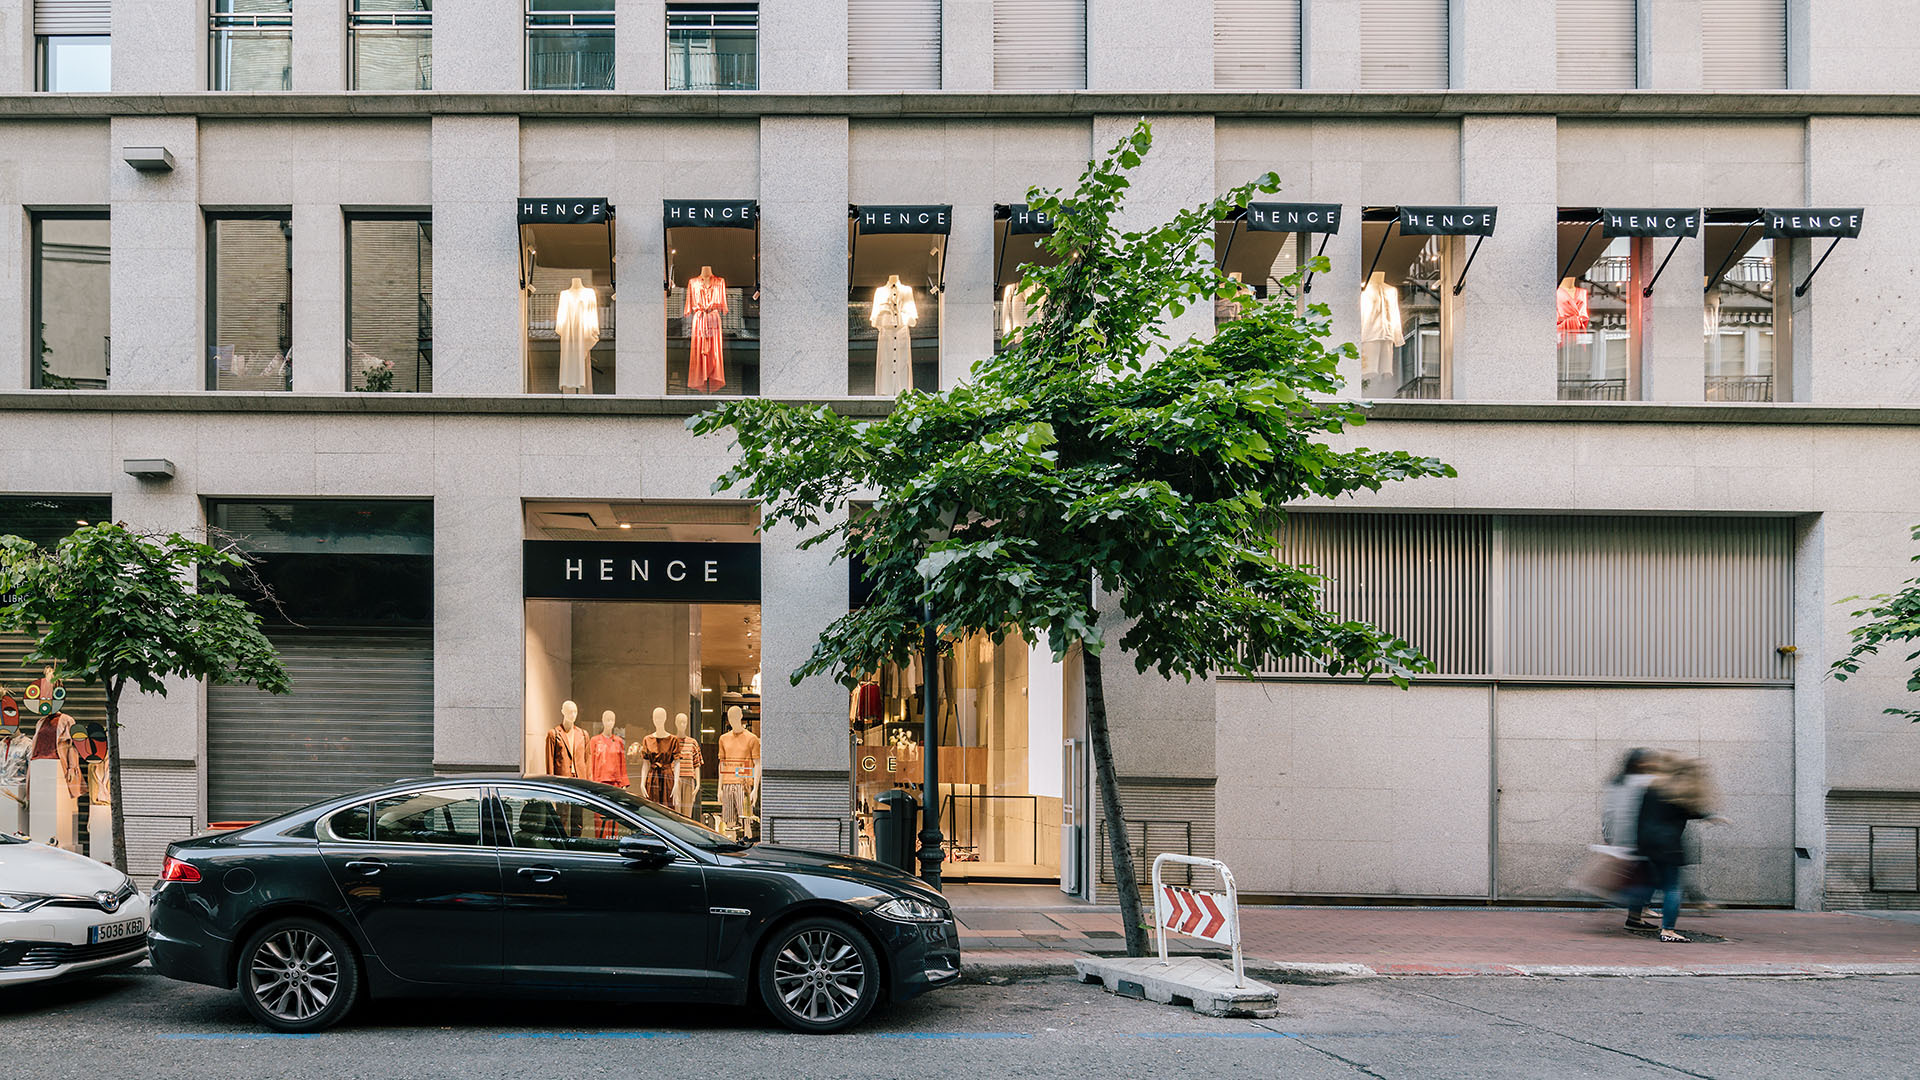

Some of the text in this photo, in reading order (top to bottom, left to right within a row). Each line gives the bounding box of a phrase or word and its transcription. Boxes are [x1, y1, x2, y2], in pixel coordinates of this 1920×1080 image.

[524, 203, 600, 216] HENCE
[671, 207, 749, 219] HENCE
[866, 212, 946, 225] HENCE
[1254, 210, 1335, 224] HENCE
[1408, 213, 1490, 227] HENCE
[1611, 215, 1695, 229] HENCE
[1773, 215, 1858, 229] HENCE
[566, 558, 718, 582] HENCE
[100, 920, 143, 940] 5036 KBD
